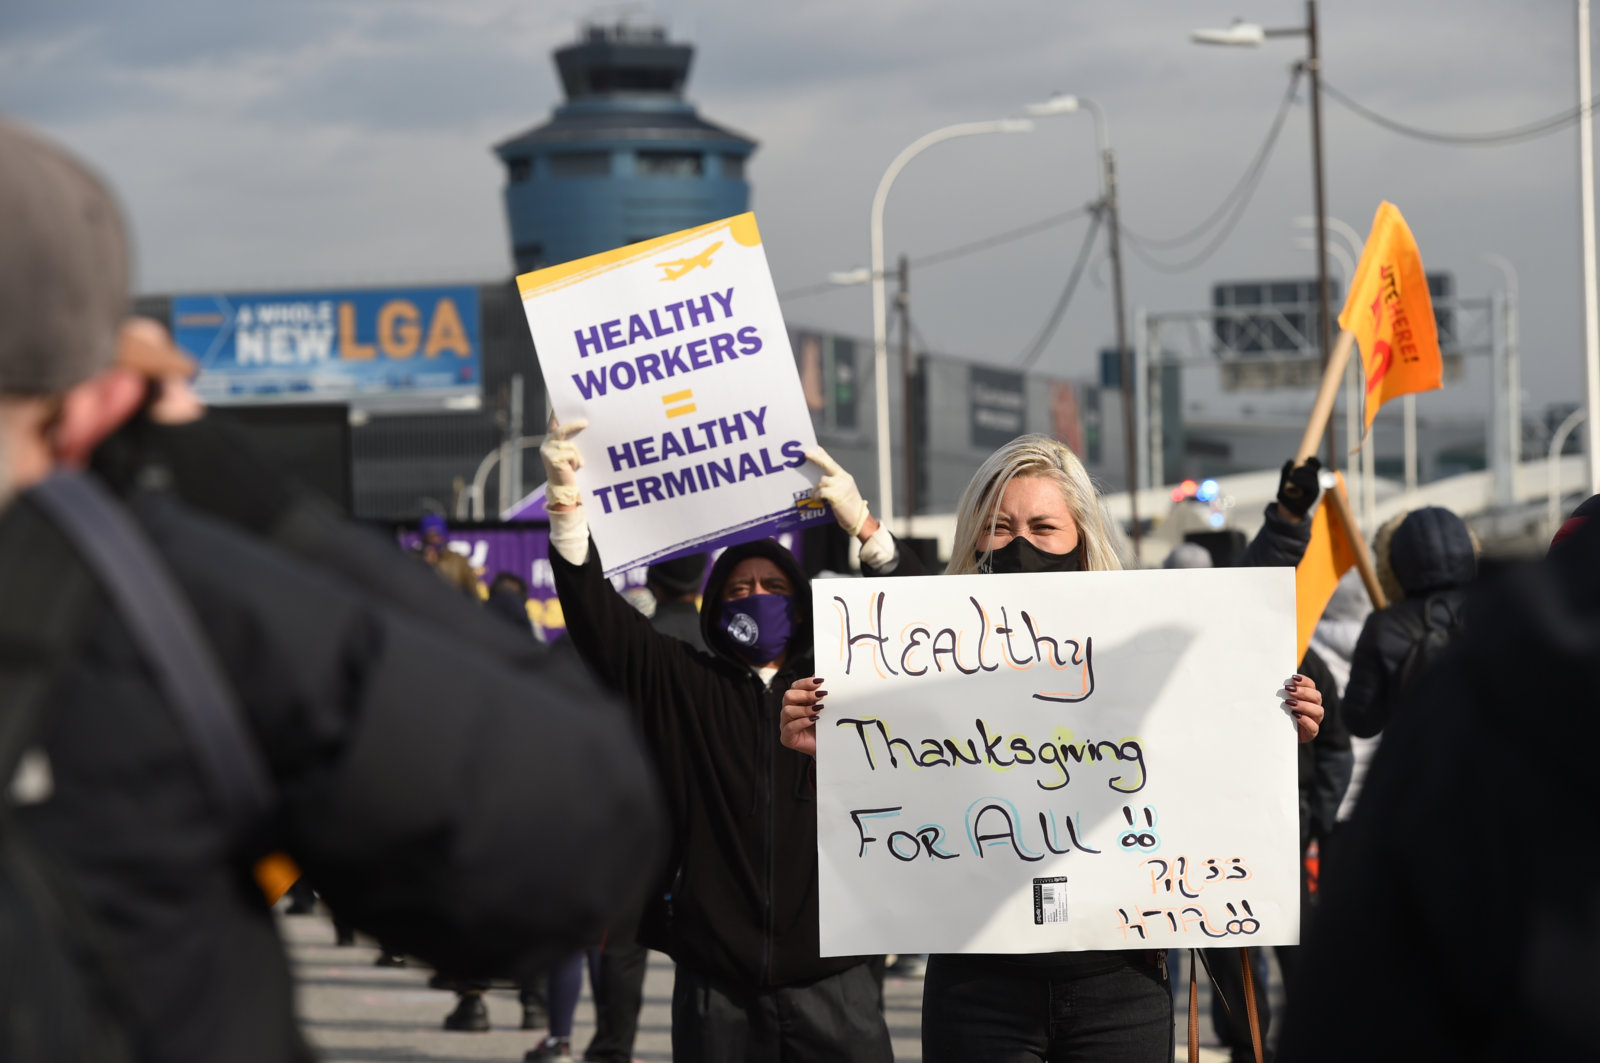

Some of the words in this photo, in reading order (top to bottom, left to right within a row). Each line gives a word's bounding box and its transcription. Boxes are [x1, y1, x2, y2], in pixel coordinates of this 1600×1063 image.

[235, 325, 334, 365] NEW
[338, 297, 471, 360] LGA
[573, 287, 735, 358] HEALTHY
[571, 326, 763, 400] WORKERS
[607, 406, 769, 472] HEALTHY
[592, 440, 808, 514] TERMINALS
[799, 507, 826, 521] SEIU
